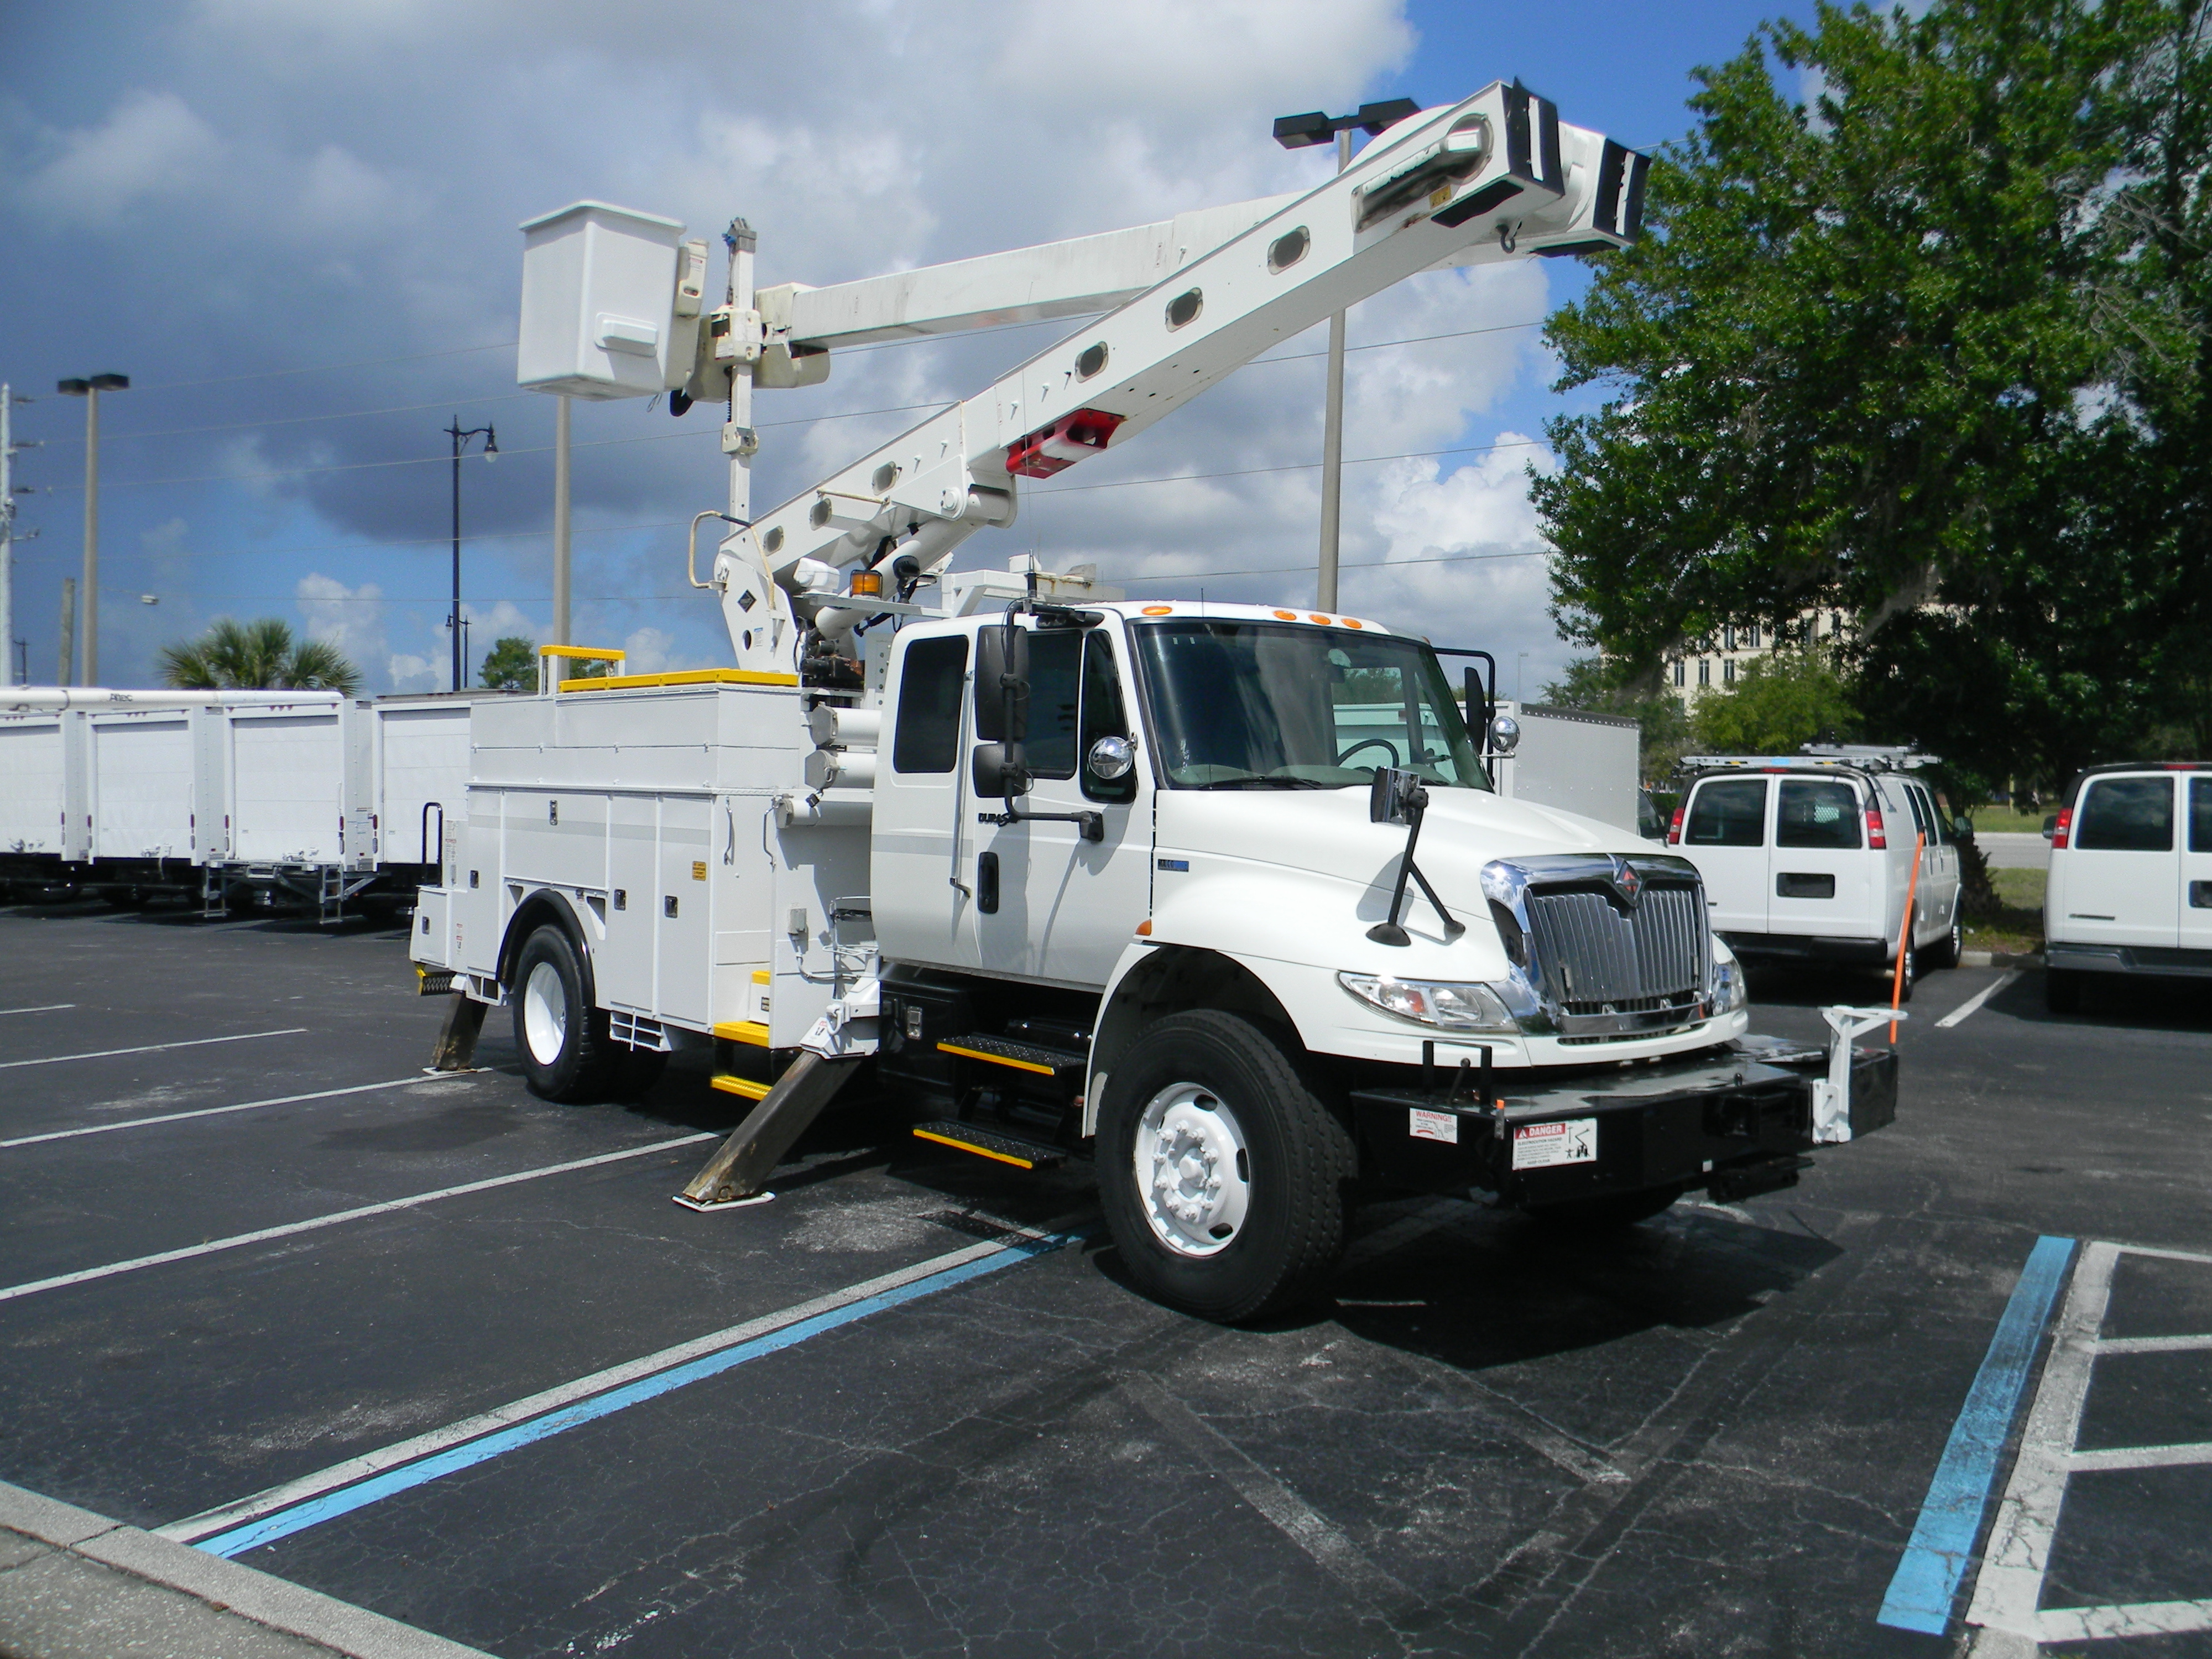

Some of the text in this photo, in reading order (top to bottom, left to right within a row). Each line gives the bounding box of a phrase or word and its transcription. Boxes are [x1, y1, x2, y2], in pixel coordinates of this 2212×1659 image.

[109, 693, 133, 702] Altec
[1416, 1110, 1452, 1123] WARNING!!
[1529, 1125, 1562, 1136] DANGER
